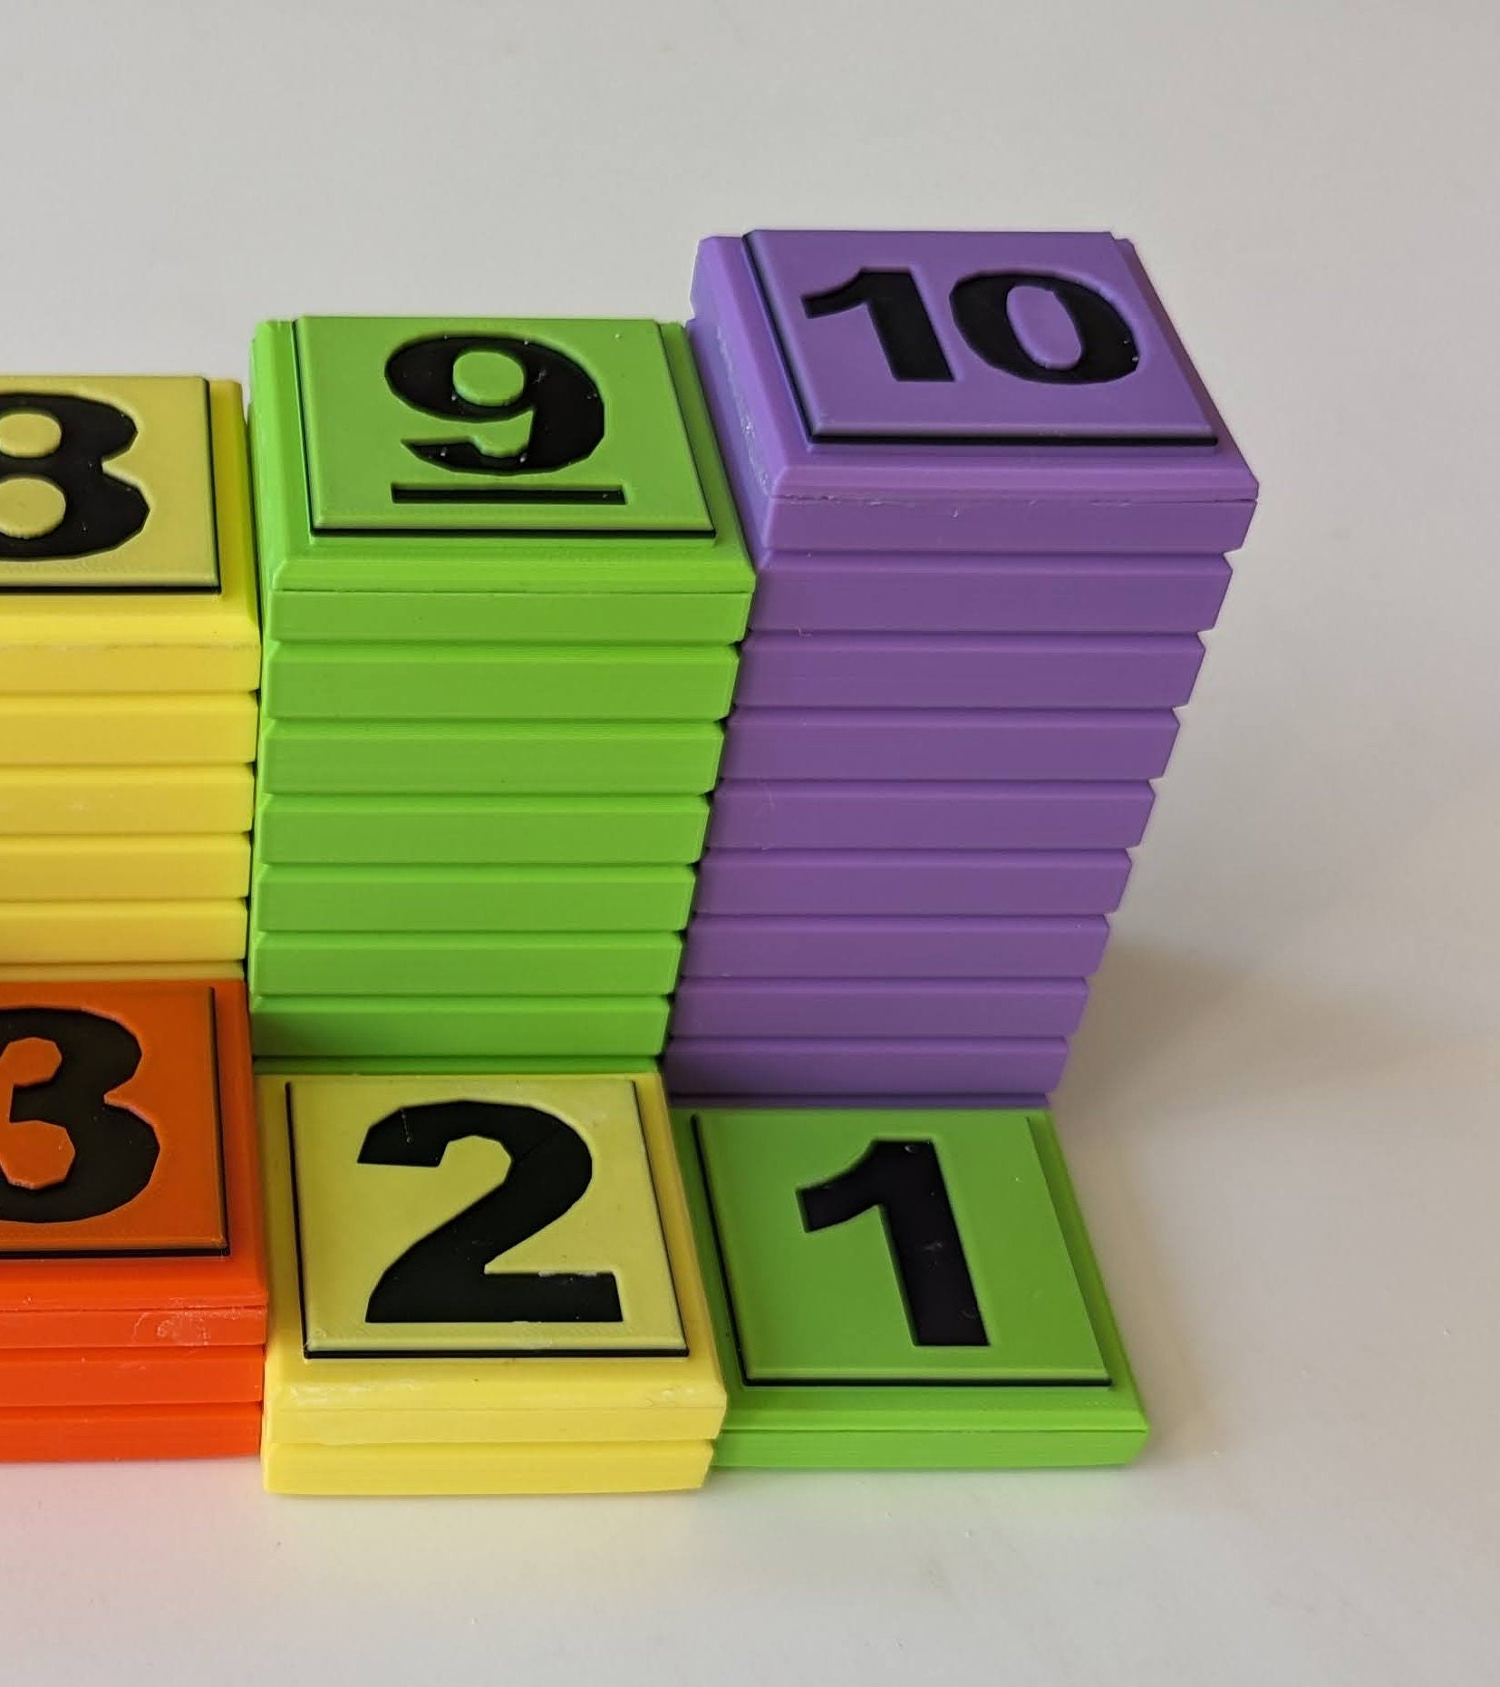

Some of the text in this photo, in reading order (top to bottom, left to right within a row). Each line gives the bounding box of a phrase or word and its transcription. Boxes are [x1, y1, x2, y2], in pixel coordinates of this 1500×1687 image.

[383, 334, 606, 477] 9
[802, 268, 1140, 386] 10
[356, 1100, 624, 1325] 2
[796, 1139, 990, 1348] 1
